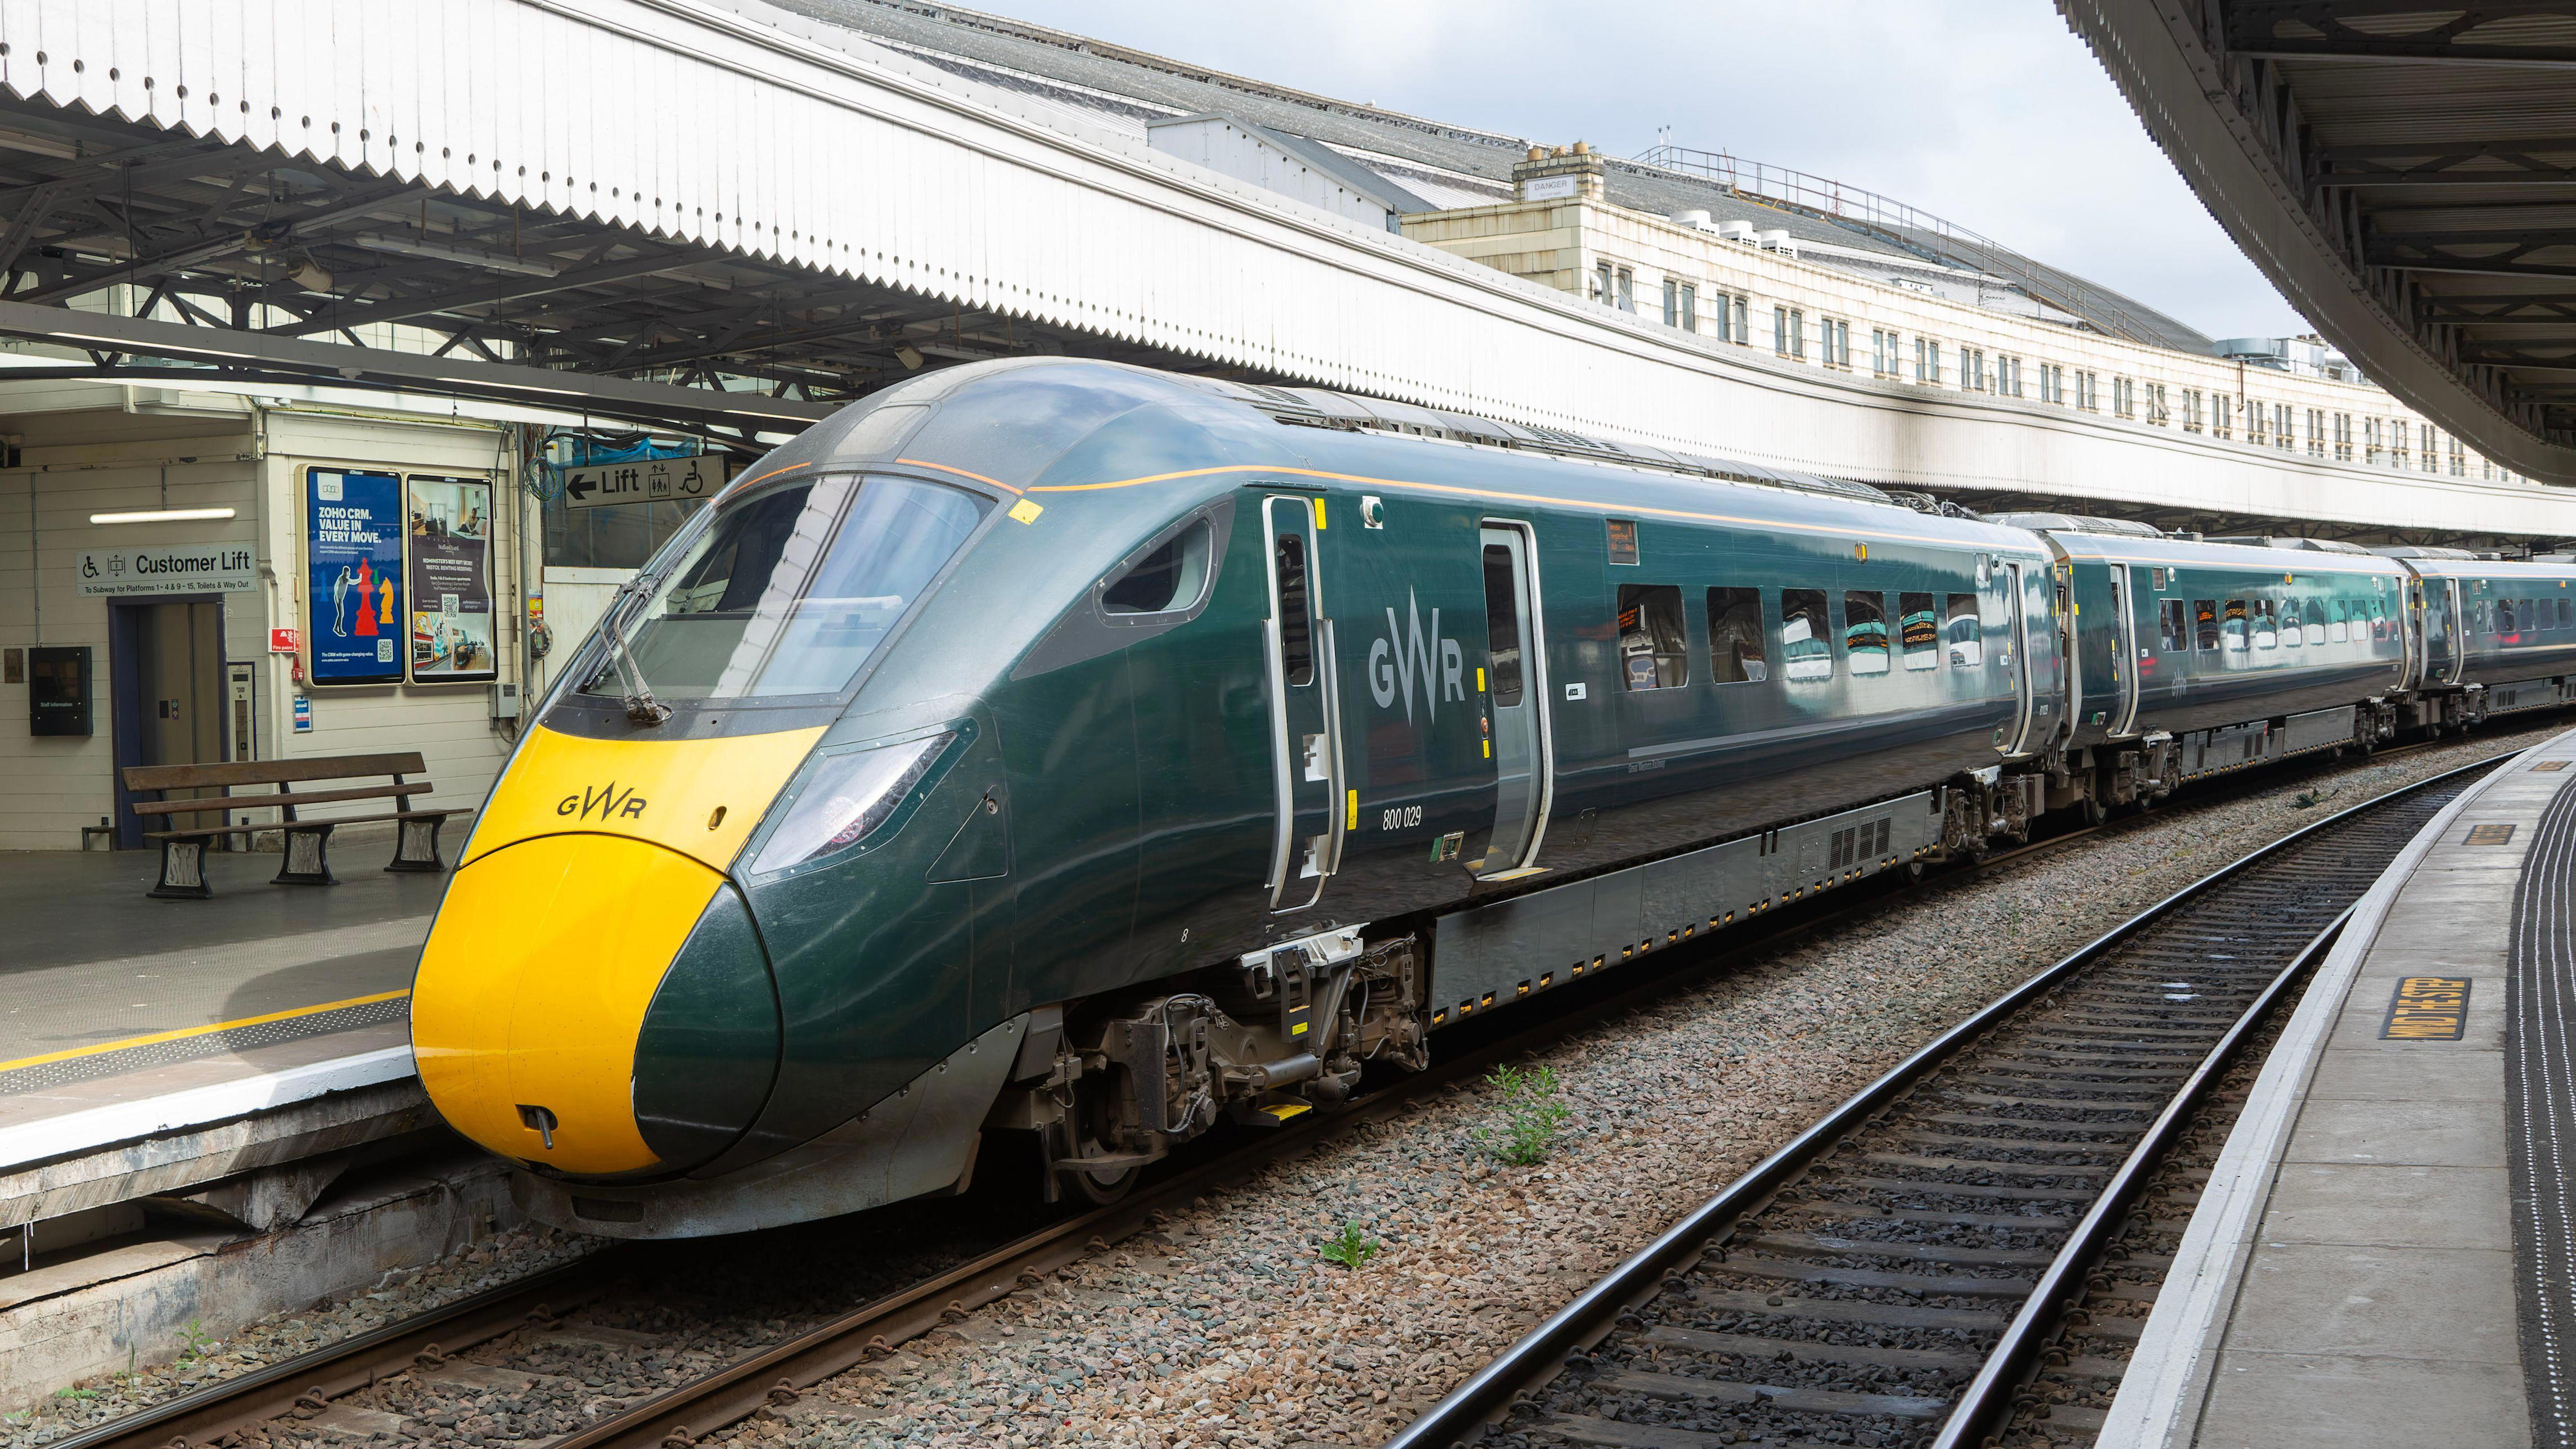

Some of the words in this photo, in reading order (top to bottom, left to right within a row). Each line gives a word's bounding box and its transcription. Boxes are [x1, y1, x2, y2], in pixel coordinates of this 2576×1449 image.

[1534, 180, 1567, 191] DANGER
[602, 468, 640, 493] Lift
[319, 507, 346, 519] ZOHO
[347, 508, 372, 520] CRM.
[319, 519, 350, 530] VALUE
[351, 520, 362, 531] IN
[319, 530, 350, 542] EVERY
[351, 532, 382, 543] MOVE.
[136, 554, 217, 574] Customer
[221, 551, 250, 570] Lift
[1368, 584, 1466, 727] GWR
[1628, 763, 1638, 773] Great
[1638, 761, 1653, 771] Western
[557, 780, 647, 822] GWR
[1382, 808, 1402, 831] 800
[1403, 805, 1422, 828] 029
[1181, 928, 1189, 942] 8
[2401, 978, 2465, 998] STEP
[2394, 999, 2461, 1015] THE
[2386, 1016, 2458, 1038] MIND
